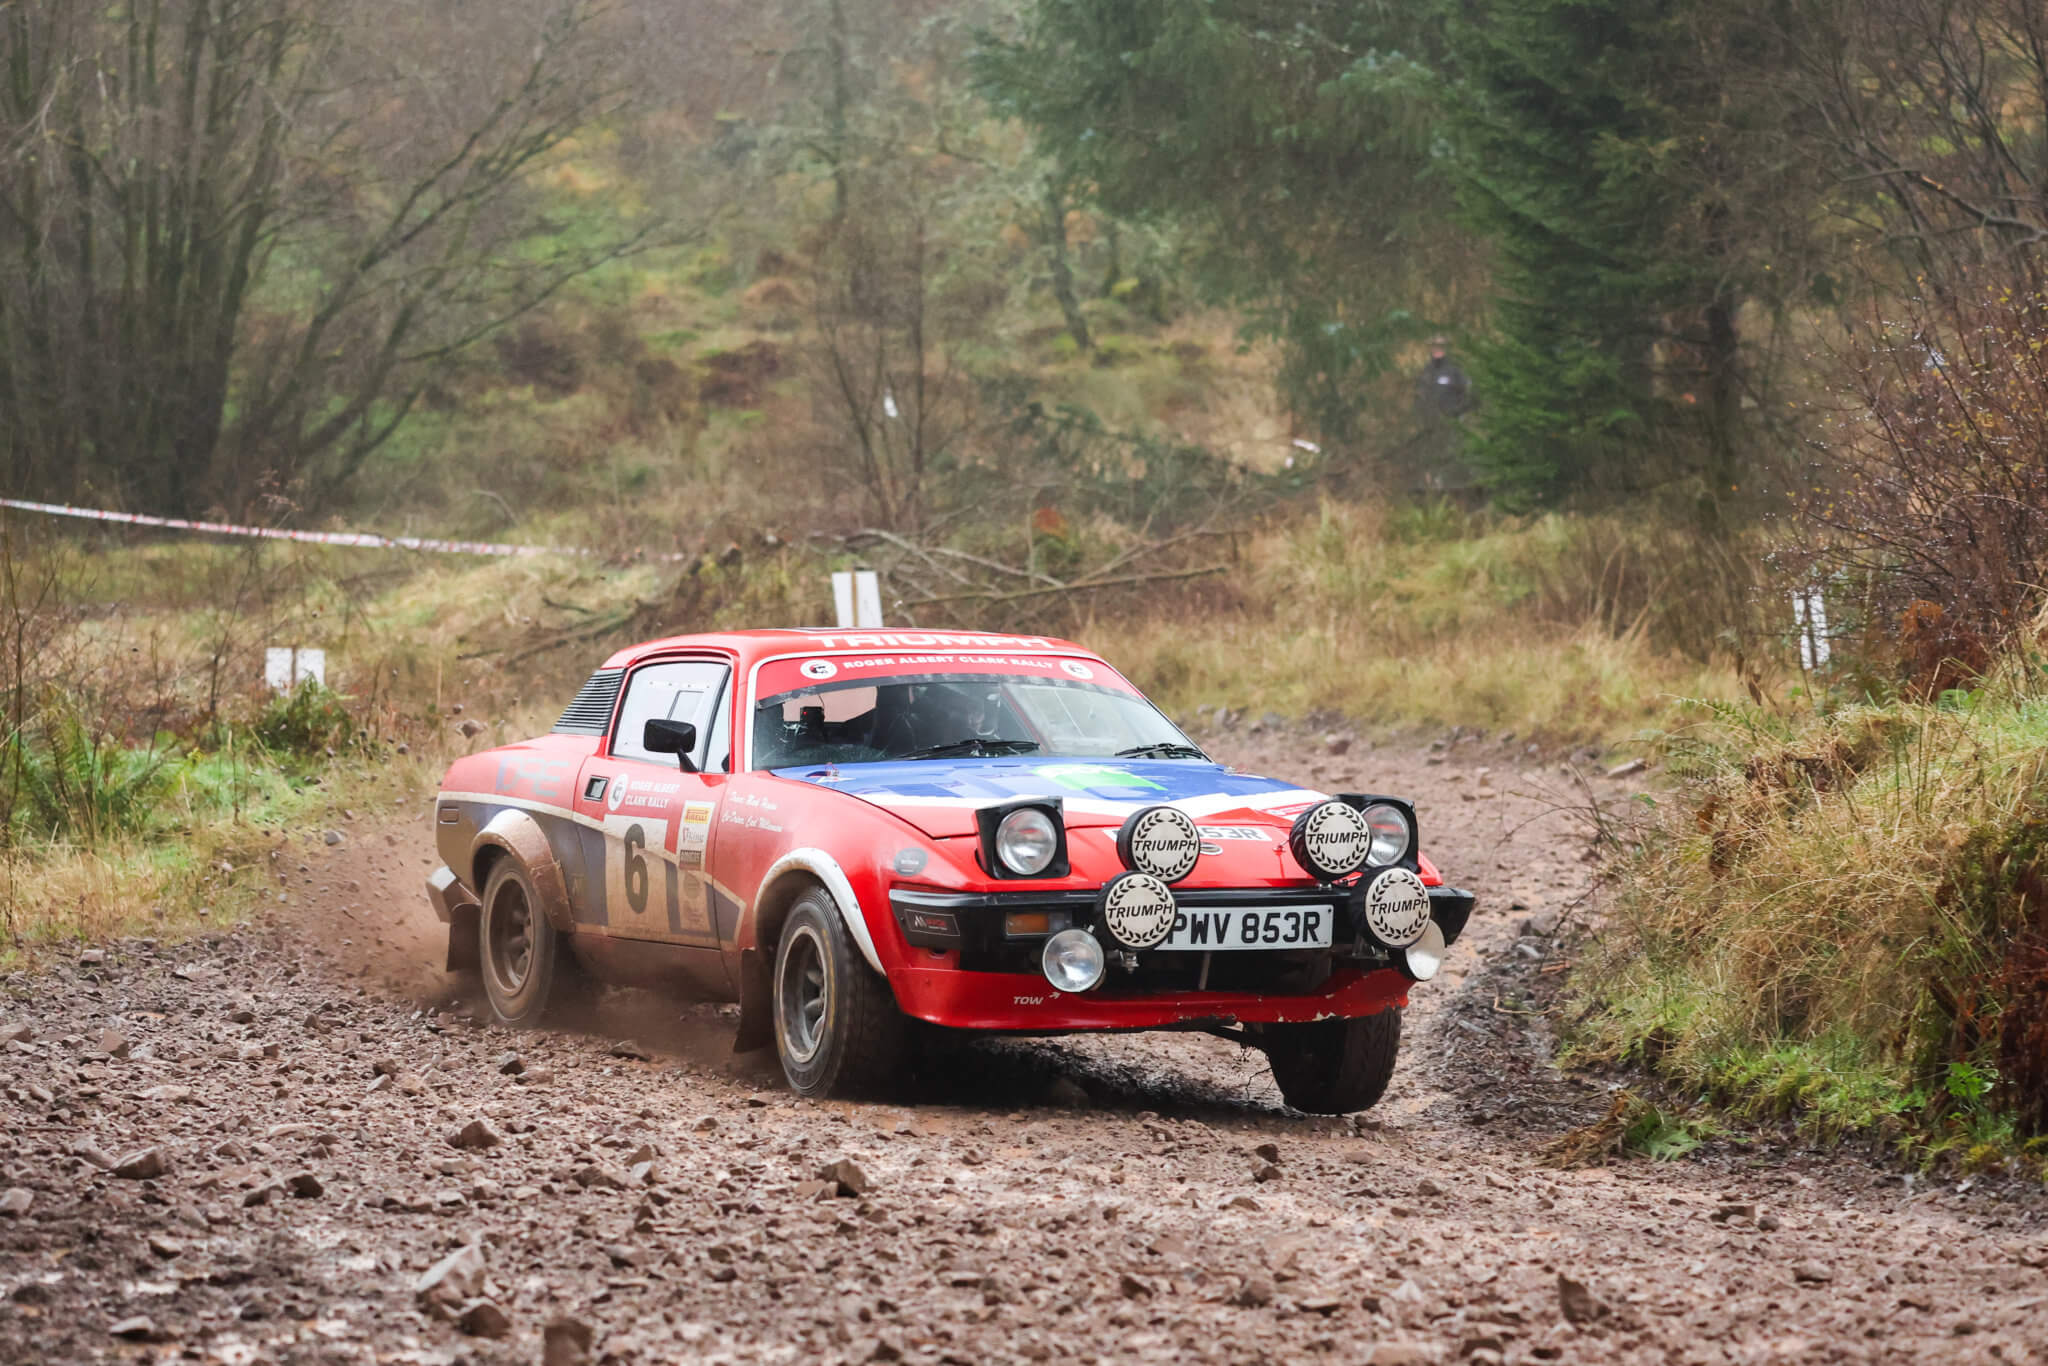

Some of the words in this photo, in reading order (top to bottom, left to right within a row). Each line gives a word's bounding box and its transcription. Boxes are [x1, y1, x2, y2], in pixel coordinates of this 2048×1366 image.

[808, 633, 1055, 649] TRIUMPH
[843, 658, 895, 669] ROGER
[899, 655, 954, 664] ALBERT
[959, 655, 1008, 665] CLARK
[1009, 658, 1054, 669] RALLY
[625, 794, 648, 806] CLARK
[648, 796, 669, 809] RALLY
[1307, 831, 1369, 844] TRIUMPH
[1134, 839, 1198, 852] TRIUMPH
[625, 823, 649, 914] 6
[1106, 903, 1173, 920] TRIUMPH
[1369, 898, 1429, 915] TRIUMPH
[1168, 912, 1231, 944] PWV
[1241, 910, 1321, 943] 853R
[1013, 995, 1043, 1006] TOW
